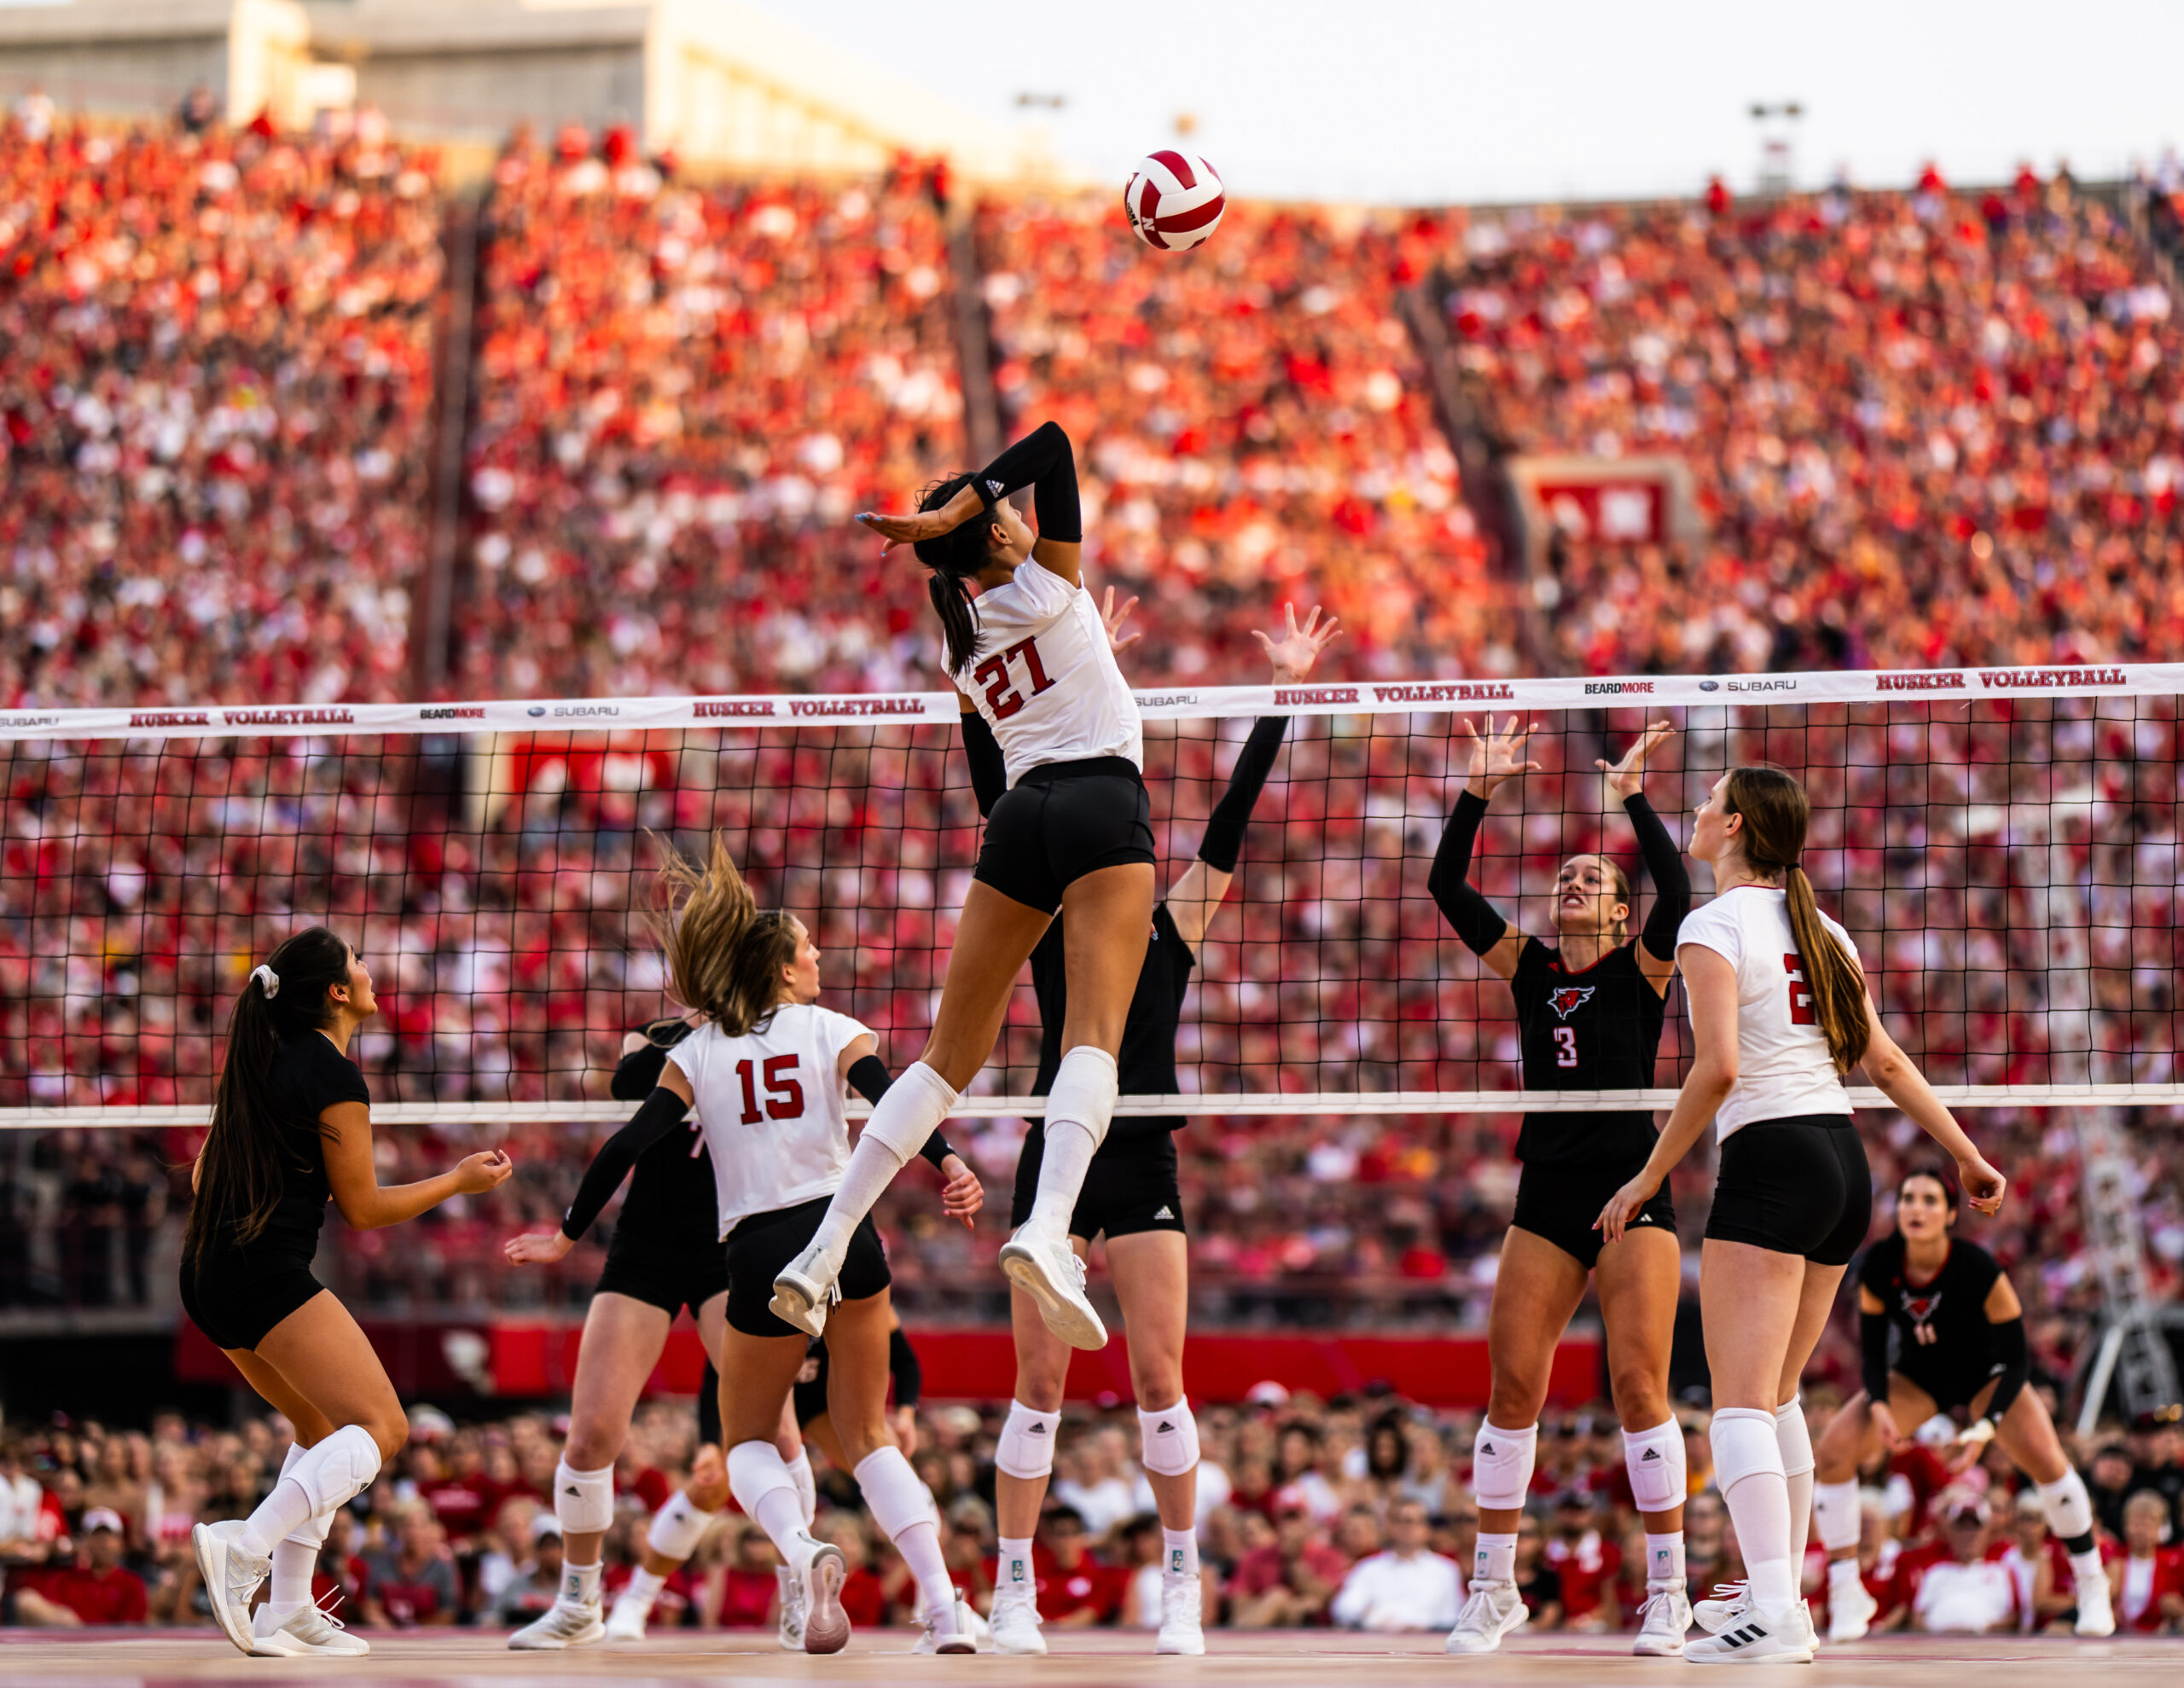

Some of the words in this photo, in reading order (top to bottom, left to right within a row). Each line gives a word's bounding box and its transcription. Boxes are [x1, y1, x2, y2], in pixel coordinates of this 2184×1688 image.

[973, 635, 1057, 720] 27
[1728, 680, 1797, 692] SUBARU
[1876, 672, 1966, 691] HUSKER
[1978, 668, 2127, 688] VOLLEYBALL
[1274, 687, 1360, 705] HUSKER
[1373, 683, 1514, 702] VOLLEYBALL
[1584, 682, 1654, 694] BEARDMORE
[420, 708, 486, 719] BEARDMORE
[554, 706, 619, 717] SUBARU
[693, 701, 775, 717] HUSKER
[789, 699, 925, 716] VOLLEYBALL
[129, 712, 211, 728] HUSKER
[224, 709, 354, 725] VOLLEYBALL
[1554, 1027, 1578, 1067] 3
[736, 1053, 804, 1125] 15
[1914, 1323, 1937, 1345] 11
